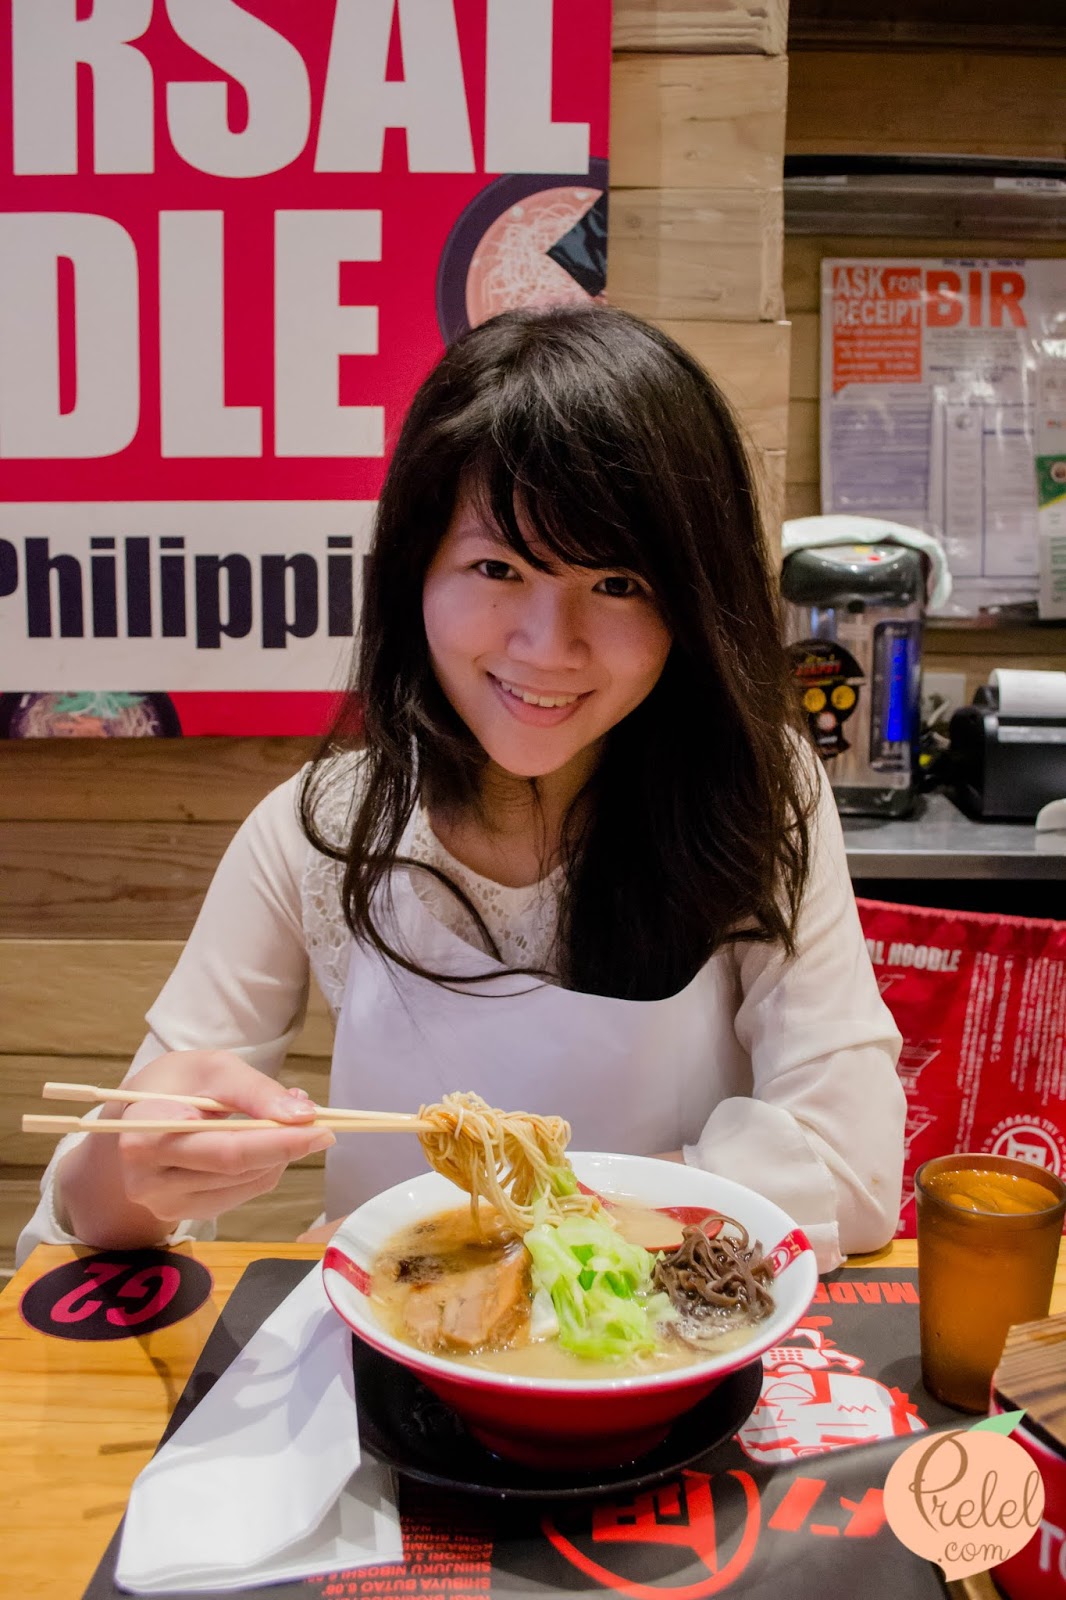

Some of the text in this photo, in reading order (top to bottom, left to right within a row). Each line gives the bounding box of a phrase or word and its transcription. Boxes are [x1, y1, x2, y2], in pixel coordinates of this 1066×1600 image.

[12, 0, 590, 178] RSAL
[837, 267, 922, 298] ASK FOR
[835, 300, 919, 325] RECEIPT
[926, 270, 1027, 327] BIR
[0, 209, 385, 458] DLE
[0, 536, 372, 648] hilippi
[887, 942, 962, 972] NOODLE
[50, 1262, 181, 1327] G2
[342, 1565, 407, 1580] NIBOSHI
[411, 1562, 491, 1575] SHINJUKU
[361, 1577, 417, 1592] BUTAO
[420, 1578, 491, 1591] SHIBUYA
